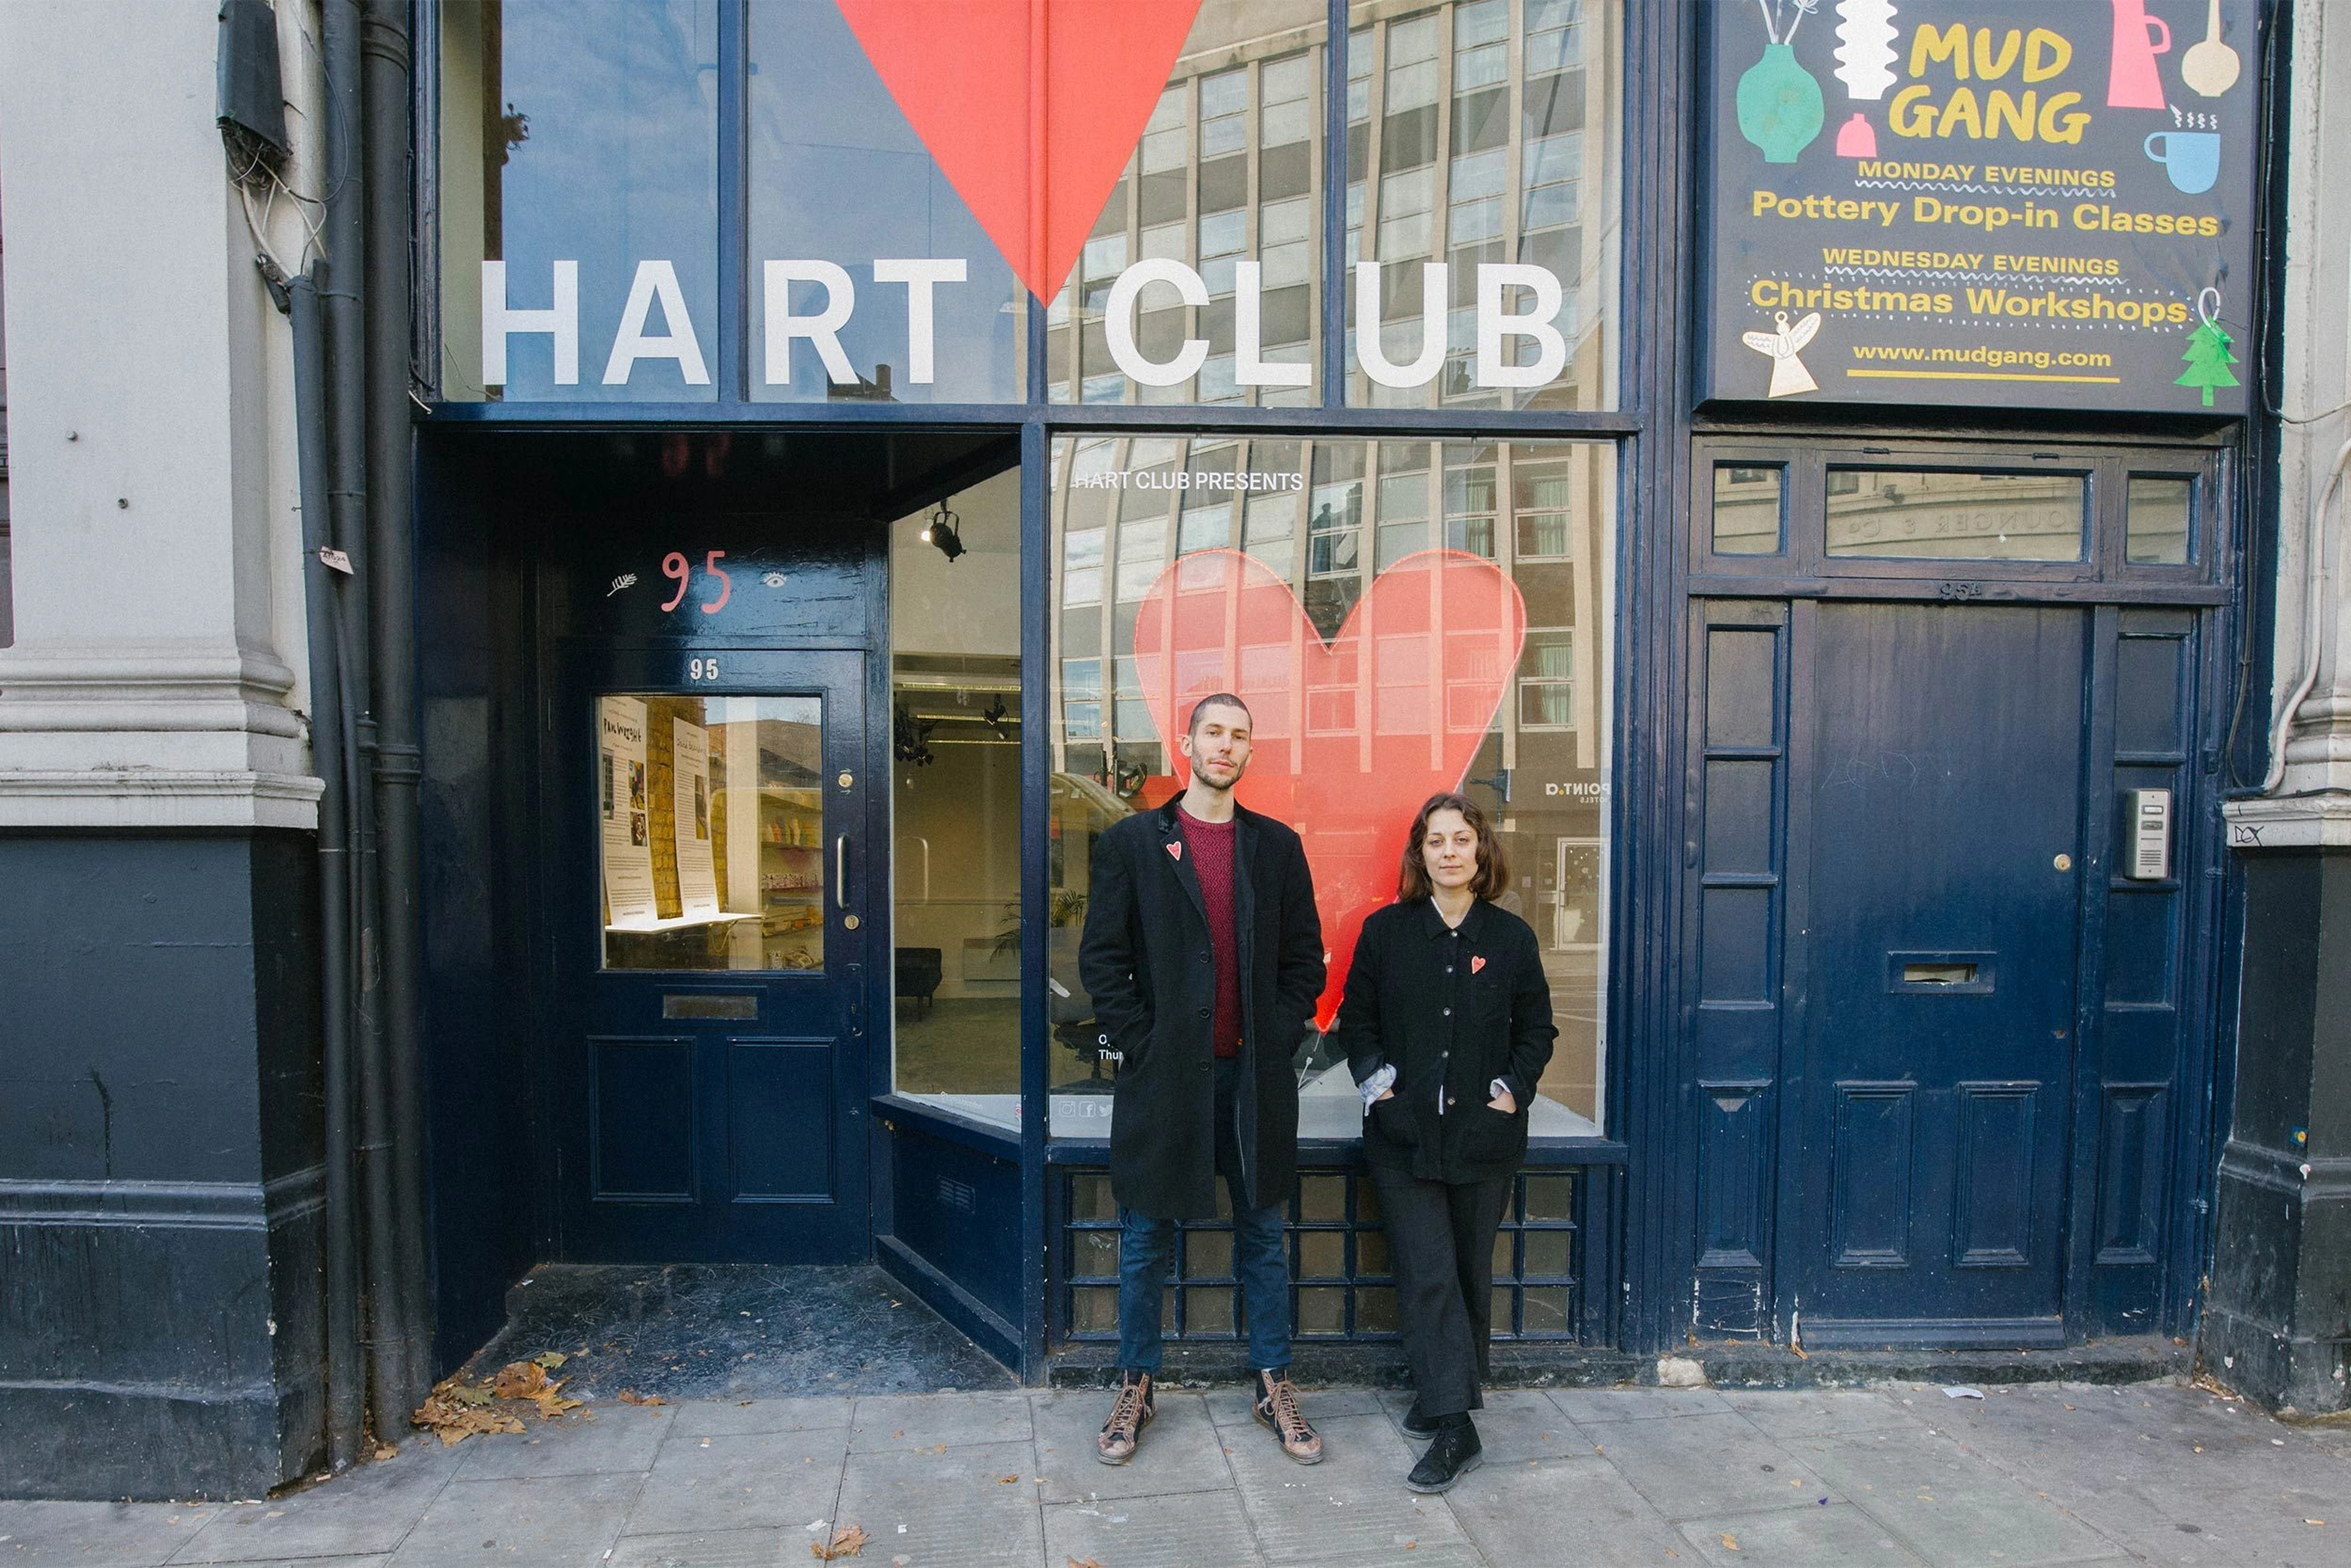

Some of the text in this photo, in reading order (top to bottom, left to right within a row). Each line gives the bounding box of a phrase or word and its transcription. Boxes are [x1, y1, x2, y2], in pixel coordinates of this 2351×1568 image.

[1909, 23, 2072, 83] MUD
[1889, 84, 2091, 145] GANG
[1858, 161, 2116, 187] MONDAY EVENINGS
[1753, 190, 2219, 237] Pottery Drop-in Classes
[1823, 248, 2120, 276] WEDNESDAY EVENINGS
[482, 258, 1567, 388] HART CLUB
[1751, 280, 2189, 328] Christmas Workshops
[1853, 345, 2112, 369] www.mudgang.com
[1075, 471, 1303, 490] HART CLUB PRESENTS
[661, 550, 730, 614] 95
[689, 658, 719, 680] 95
